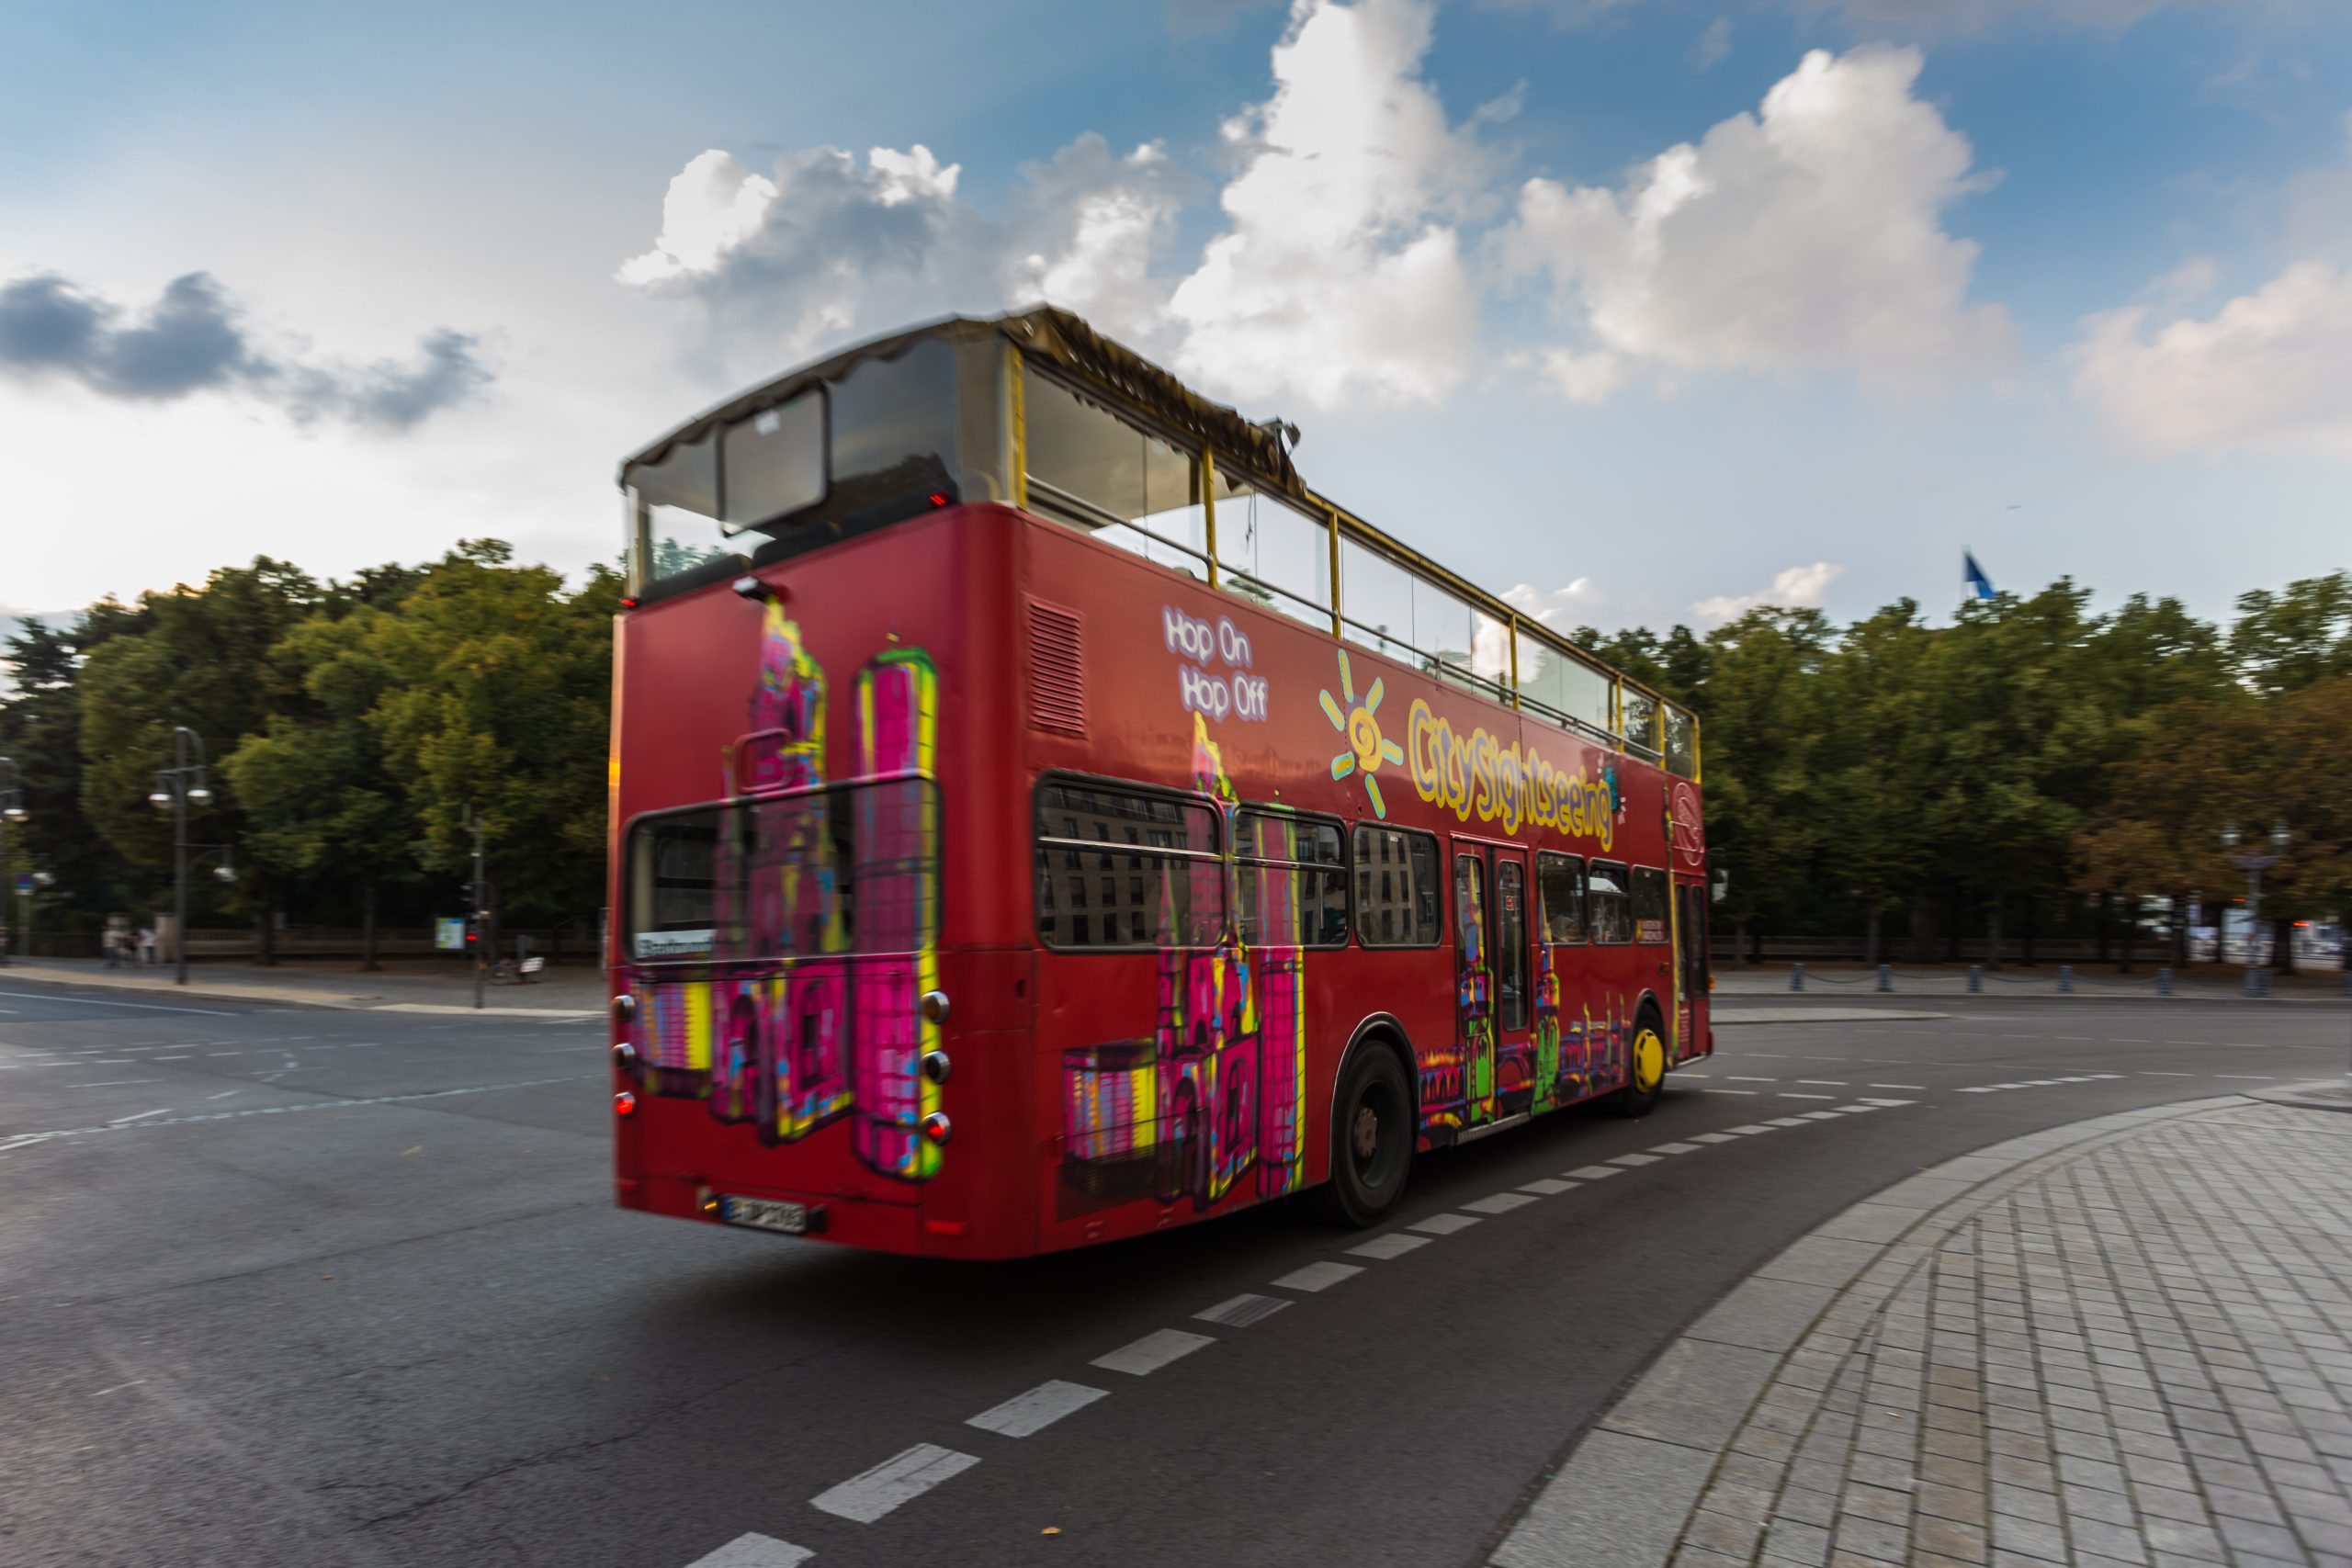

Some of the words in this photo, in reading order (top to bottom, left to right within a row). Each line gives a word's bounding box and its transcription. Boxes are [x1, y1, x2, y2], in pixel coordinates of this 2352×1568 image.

[1163, 608, 1215, 662] Hop
[1217, 618, 1250, 663] On
[1181, 668, 1229, 718] Hop
[1233, 674, 1266, 717] Off
